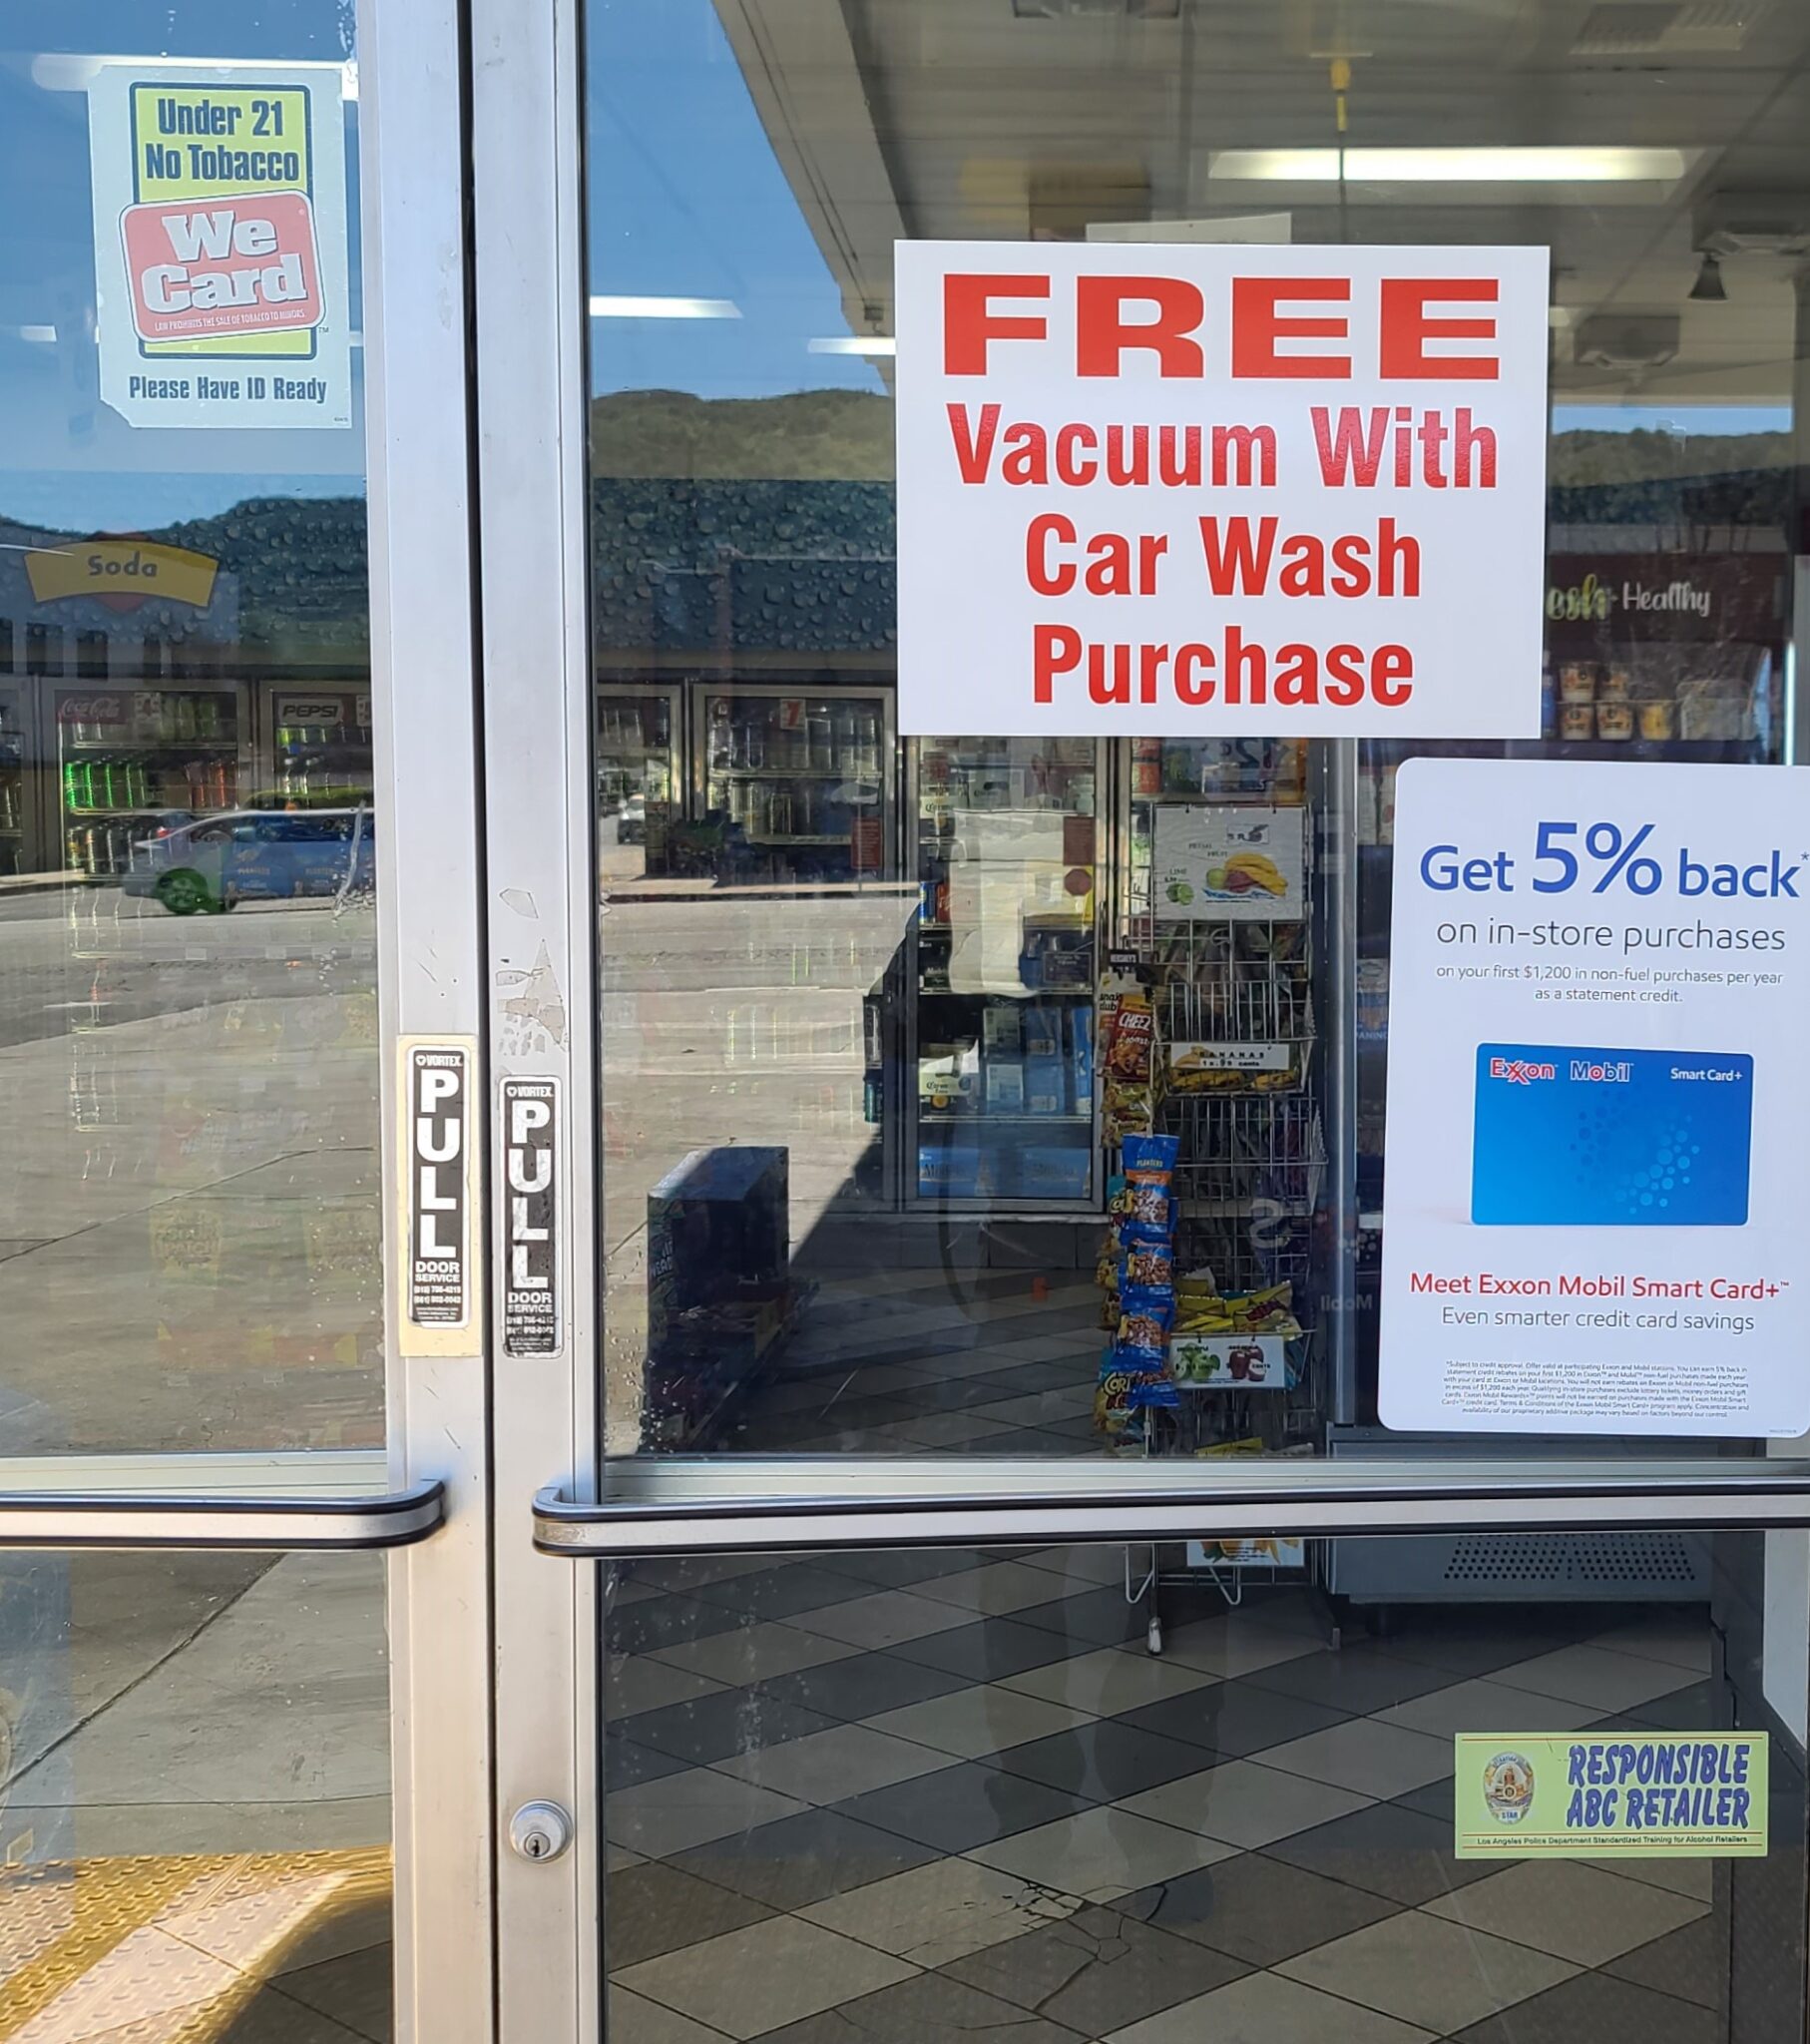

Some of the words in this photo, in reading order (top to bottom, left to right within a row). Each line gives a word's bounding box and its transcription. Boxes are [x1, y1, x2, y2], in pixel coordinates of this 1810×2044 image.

[158, 98, 242, 136] Under
[251, 101, 284, 137] 21
[145, 143, 181, 180] No
[188, 145, 299, 182] Tobacco
[162, 211, 278, 263] We
[142, 253, 309, 314] Card
[943, 273, 1501, 381] FREE
[129, 375, 191, 400] Please
[197, 376, 239, 400] Have
[247, 377, 266, 400] ID
[273, 378, 327, 404] Ready
[946, 402, 1277, 487] Vacuum
[1310, 406, 1498, 489] With
[88, 552, 158, 578] Soda
[1025, 512, 1168, 598] Car
[1197, 515, 1422, 598] Wash
[1622, 582, 1711, 618] Healthy
[1033, 623, 1415, 708] Purchase
[282, 705, 339, 718] PEPSI
[1419, 844, 1515, 892] Get
[1532, 820, 1662, 896] 5%
[1437, 920, 1477, 945] on
[1488, 917, 1613, 948] in-store
[1623, 919, 1786, 955] purchases
[1436, 966, 1454, 978] on
[1457, 966, 1491, 981] your
[1493, 964, 1520, 979] first
[1524, 964, 1572, 981] $1,200
[1575, 965, 1587, 980] in
[1590, 966, 1650, 982] non-fuel
[1653, 968, 1724, 986] purchases
[1726, 972, 1749, 987] per
[1752, 973, 1783, 988] year
[1535, 989, 1551, 1000] as
[1554, 990, 1563, 1000] a
[1566, 987, 1636, 1002] statement
[1639, 988, 1684, 1003] credit.
[426, 1055, 463, 1067] VORTEX
[1490, 1057, 1557, 1085] Exxon
[1570, 1060, 1631, 1083] Mobil
[1670, 1067, 1706, 1081] Smart
[1707, 1068, 1743, 1082] Card+
[517, 1086, 554, 1098] VORTEX
[416, 1068, 461, 1259] PULL
[508, 1100, 552, 1288] PULL
[415, 1261, 460, 1274] DOOR
[415, 1274, 460, 1282] SERVICE
[508, 1291, 552, 1303] DOOR
[1410, 1273, 1472, 1295] Meet
[1478, 1275, 1551, 1296] Exxon
[1559, 1275, 1625, 1297] Mobil
[1632, 1278, 1703, 1298] Smart
[508, 1303, 552, 1313] SERVICE
[1442, 1307, 1490, 1326] Even
[1494, 1308, 1571, 1328] smarter
[1576, 1308, 1631, 1328] credit
[1635, 1309, 1678, 1329] card
[1683, 1311, 1755, 1335] savings
[1569, 1744, 1750, 1788] RESPONSIBLE
[1567, 1788, 1618, 1827] ABC
[1625, 1787, 1750, 1829] RETAILER
[1492, 1837, 1522, 1846] Angeles
[1643, 1836, 1672, 1845] Training
